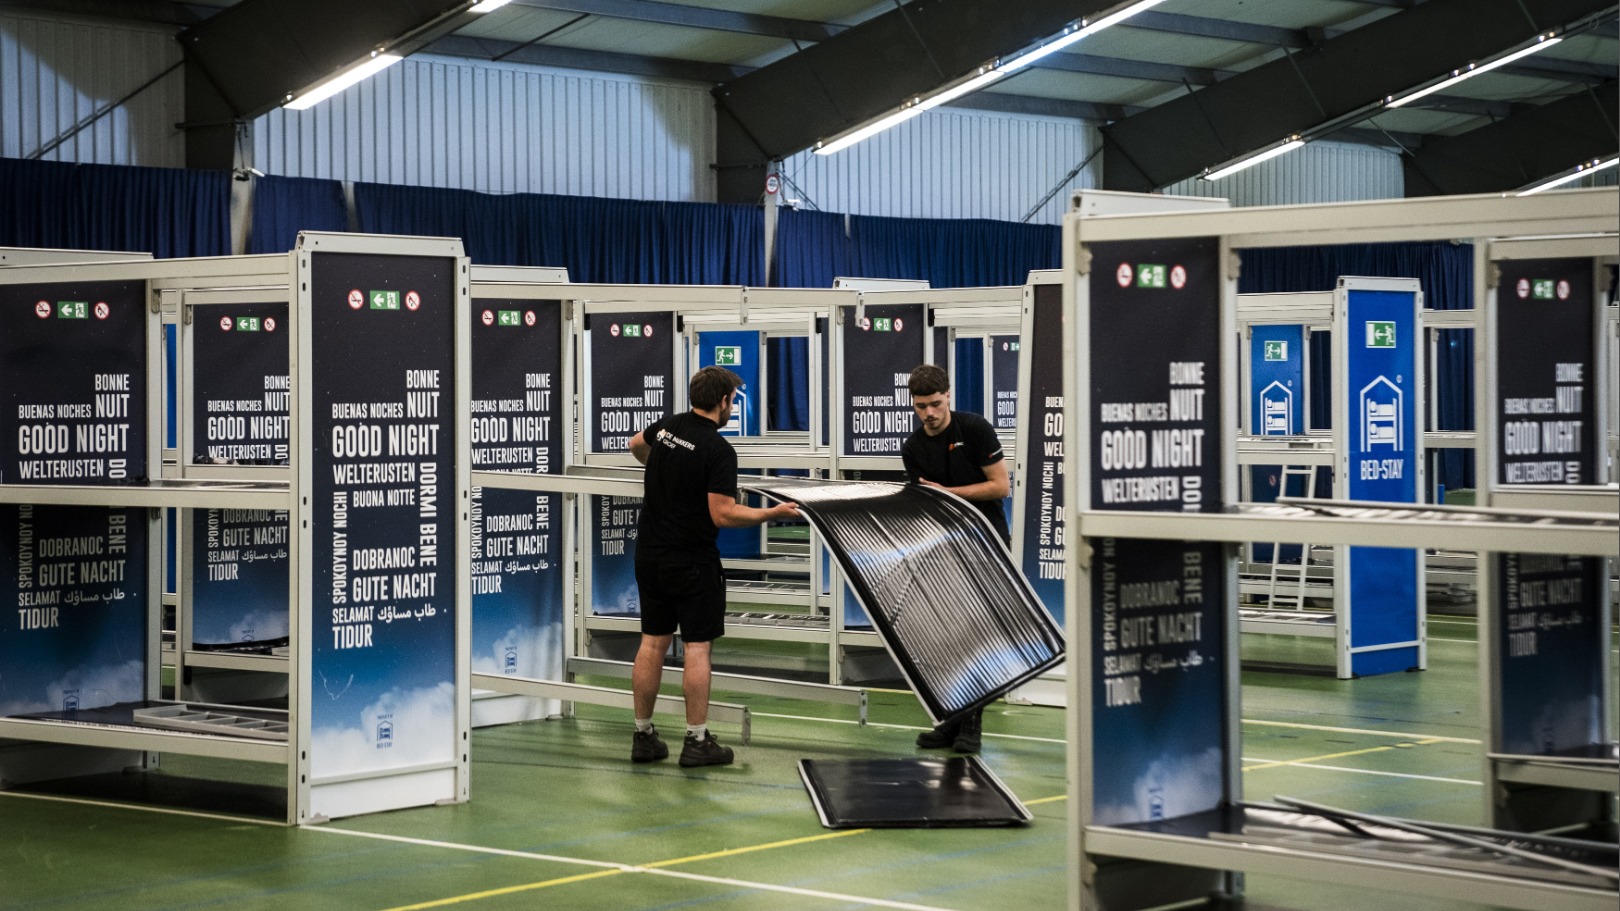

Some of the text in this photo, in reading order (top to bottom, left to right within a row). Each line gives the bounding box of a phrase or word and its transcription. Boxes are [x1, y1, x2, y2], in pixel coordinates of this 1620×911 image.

[95, 374, 129, 390] BONNE
[264, 375, 290, 389] BONNE
[406, 370, 440, 388] BONNE
[526, 374, 550, 388] BONNE
[644, 376, 664, 388] BONNE
[895, 373, 912, 386] BONN
[96, 394, 130, 418] NUIT
[208, 400, 262, 411] BUENAS NOCHES
[265, 392, 290, 411] NUIT
[407, 392, 440, 417] NUIT
[471, 400, 523, 412] BUENAS NOCHES
[527, 391, 550, 411] NUIT
[645, 390, 664, 407] NUIT
[853, 396, 872, 406] BUENAS
[998, 401, 1014, 415] GOOD
[1046, 397, 1064, 408] BUEN
[1170, 389, 1204, 421] NUIT
[19, 404, 91, 418] BUENAS NOCHES
[332, 402, 403, 419] BUENAS NOCHES
[208, 416, 290, 440] GOOD NIGHT
[471, 417, 550, 443] GOOD NIGHT
[601, 412, 630, 432] GOOD
[853, 411, 914, 433] GOOD NIGHT
[1044, 413, 1063, 436] GO
[19, 424, 129, 454] GOOD NIGHT
[332, 424, 439, 457] GOOD NIGHT
[602, 437, 630, 449] WELTER
[853, 438, 900, 452] WELTERUSTEN
[208, 444, 271, 459] WELTERUSTEN
[472, 447, 533, 464] WELTERUSTEN
[1101, 429, 1204, 470] GOOD NIGHT
[19, 459, 103, 479] WELTERUSTEN
[333, 462, 415, 484] WELTERUSTEN
[1361, 459, 1404, 480] BED-STAY
[353, 489, 415, 507] BUONA NOTTE
[536, 447, 548, 529] DOR BENE
[1102, 476, 1179, 503] WELTERUSTEN
[1040, 462, 1054, 545] SPOKOYNOY NOCHI
[420, 462, 437, 567] DORMI BENE
[487, 514, 533, 532] DOBRANOC
[613, 510, 633, 526] GUTE
[109, 515, 126, 554] BENE
[208, 508, 219, 548] SPOKOYN
[223, 526, 287, 546] GUTE NACHT
[472, 502, 482, 559] SPOKOYNOY
[602, 528, 625, 539] SELAMAT
[19, 523, 32, 588] SPOKOYNOY
[40, 536, 103, 557] DOBRANOC
[208, 550, 239, 562] SELAMAT
[333, 491, 347, 604] SPOKOYNOY NOCHI
[487, 535, 548, 557] GUTE NACHT
[602, 540, 624, 555] TIDUR
[353, 546, 415, 570] DOBRANOC
[472, 561, 503, 574] SELAMAT
[39, 560, 125, 587] GUTE NACHT
[208, 563, 238, 581] TIDUR
[1184, 552, 1202, 603] BENE
[353, 572, 436, 602] GUTE NACHT
[472, 575, 502, 594] TIDUR
[19, 590, 60, 606] SELAMAT
[19, 607, 58, 630] TIDUR
[332, 606, 374, 624] SELAMAT
[415, 603, 436, 621] طاب
[332, 624, 372, 649] TIDUR
[1121, 612, 1202, 648] GUTE NACHT
